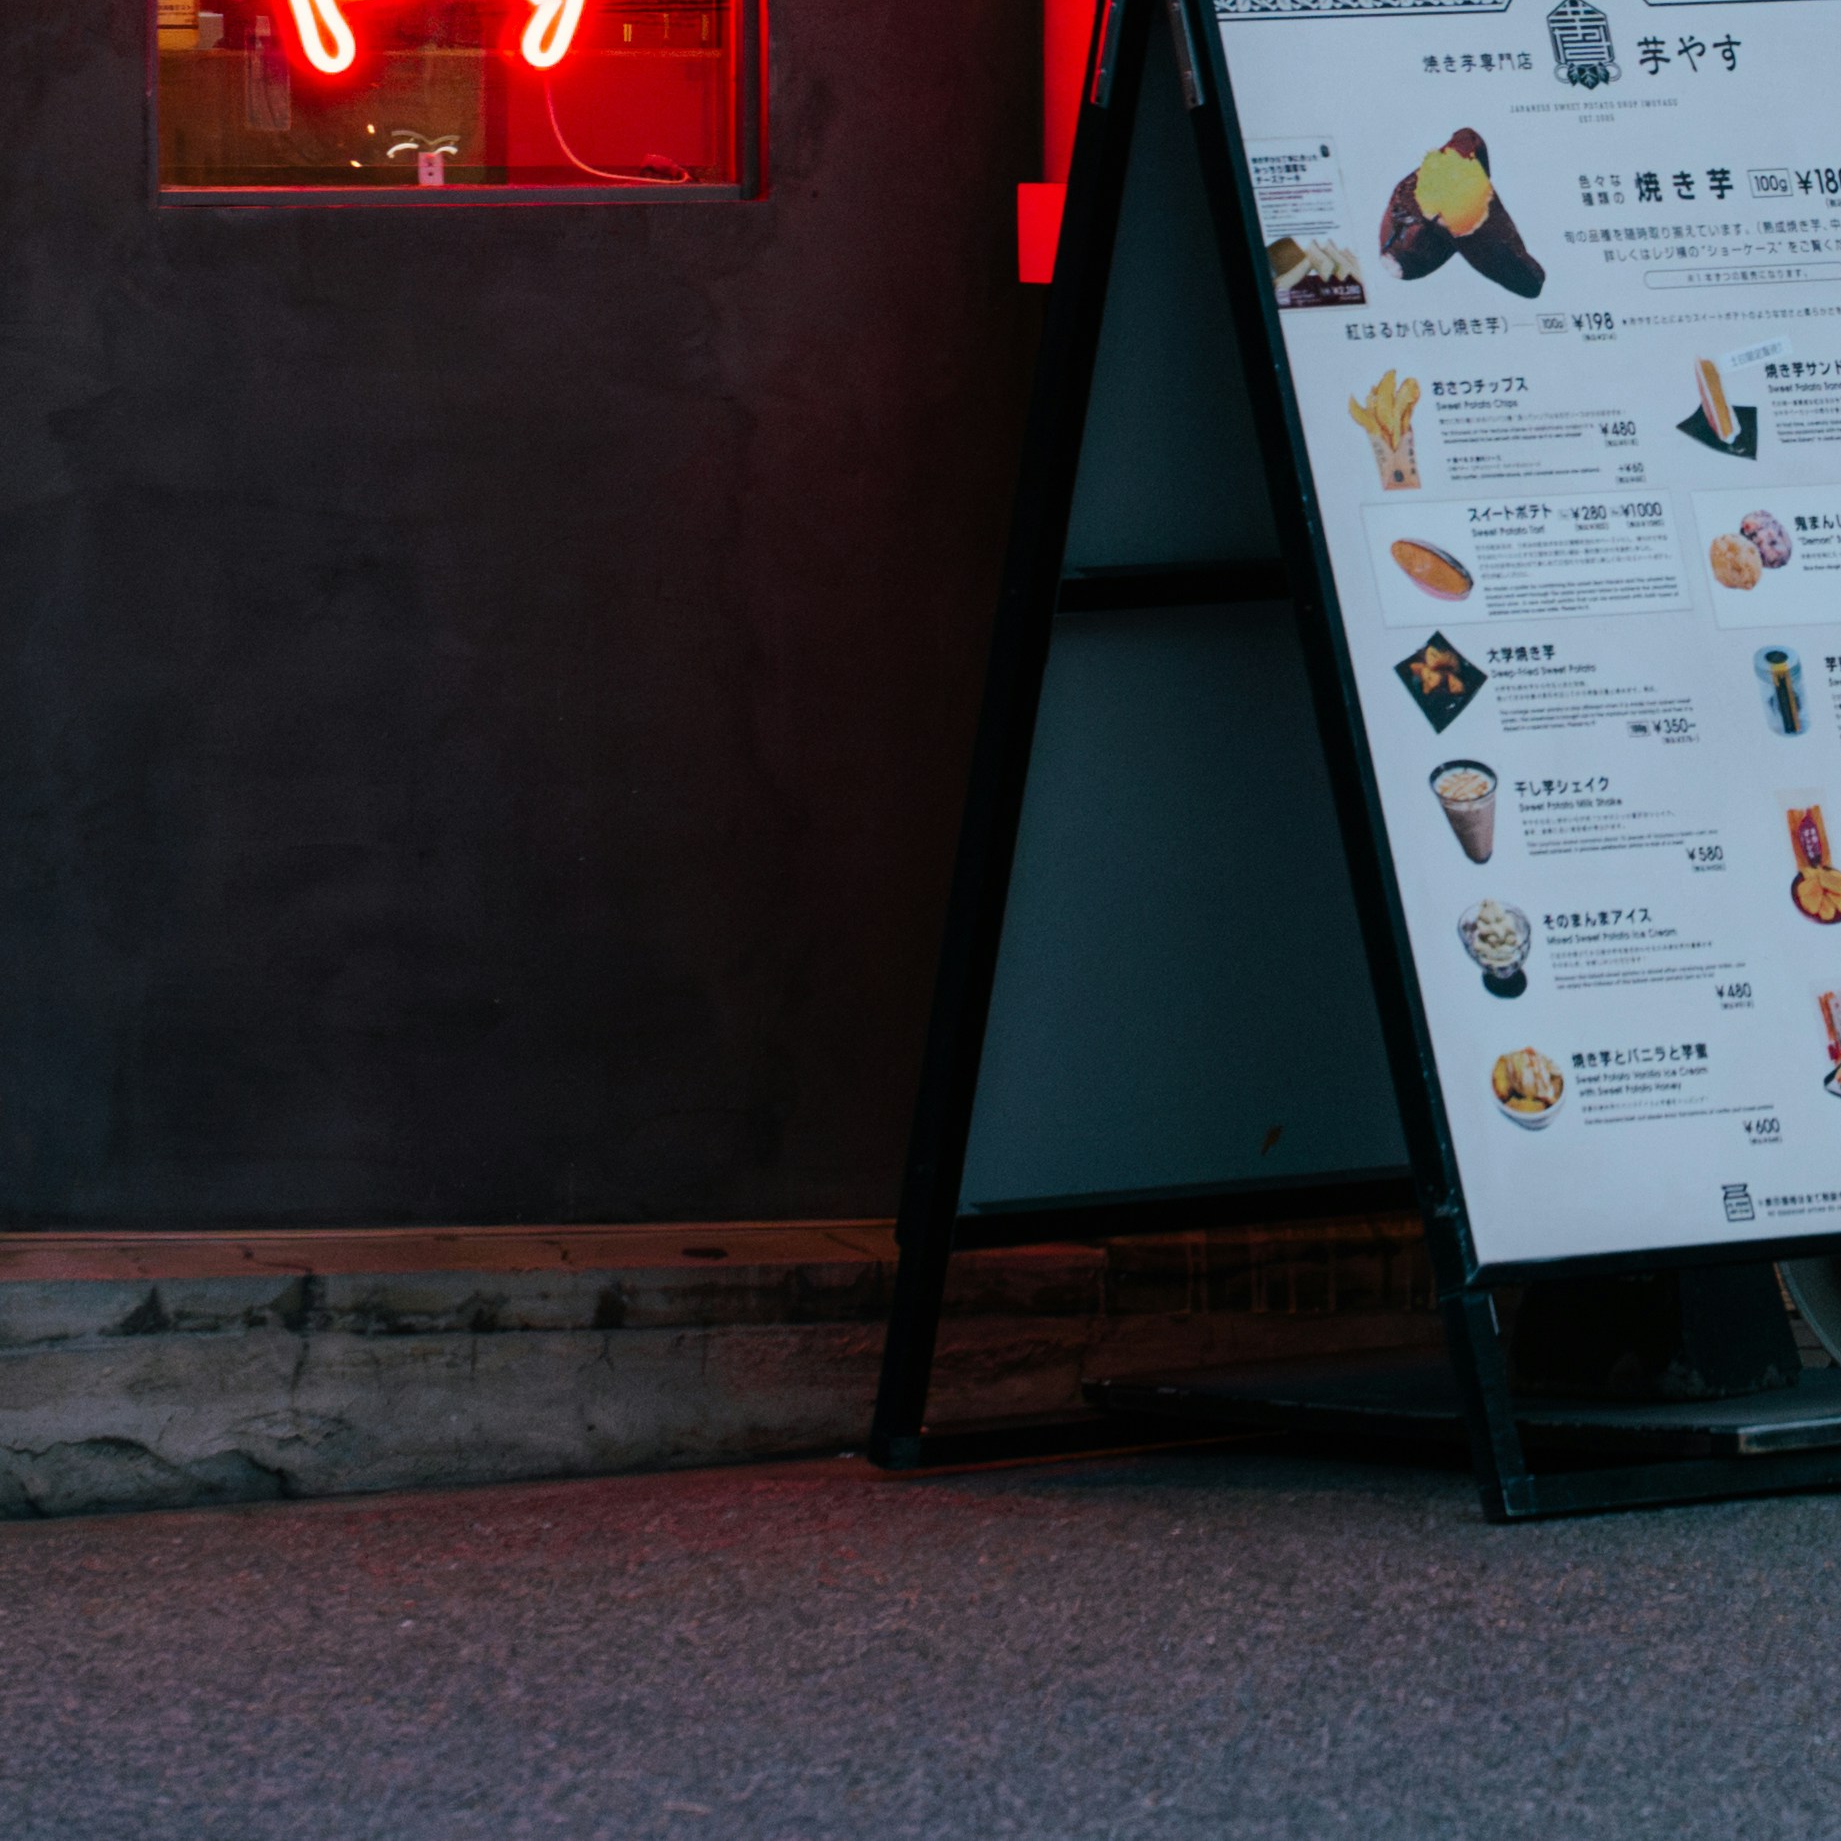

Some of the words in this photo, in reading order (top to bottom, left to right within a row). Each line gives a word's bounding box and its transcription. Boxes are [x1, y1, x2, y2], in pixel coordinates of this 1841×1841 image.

[1422, 52, 1534, 75] 焼き芋専門店
[1637, 33, 1742, 76] 芋やす
[1578, 173, 1623, 189] 色々な
[1633, 167, 1735, 203] 焼き芋
[1753, 173, 1788, 194] 100g
[1570, 312, 1615, 331] ¥198
[1431, 376, 1529, 397] おさつチップス
[1768, 383, 1792, 394] Sweet
[1794, 381, 1822, 393] Potato
[1435, 400, 1461, 412] Sweet
[1463, 399, 1491, 411] Potato
[1492, 397, 1519, 411] Chips
[1600, 421, 1637, 437] ¥480
[1466, 503, 1553, 523] スイートポテト
[1570, 504, 1607, 521] ¥280
[1622, 502, 1663, 518] ¥1000
[1485, 643, 1556, 663] 大学焼き芋
[1514, 775, 1610, 798] 干し芋シェイク
[1686, 844, 1724, 862] ¥580
[1542, 907, 1653, 930] そのまんまアイス
[1715, 982, 1753, 999] ¥480
[1571, 1042, 1709, 1070] 焼き芋とバニラと芋蜜
[1743, 1117, 1781, 1134] ¥600
